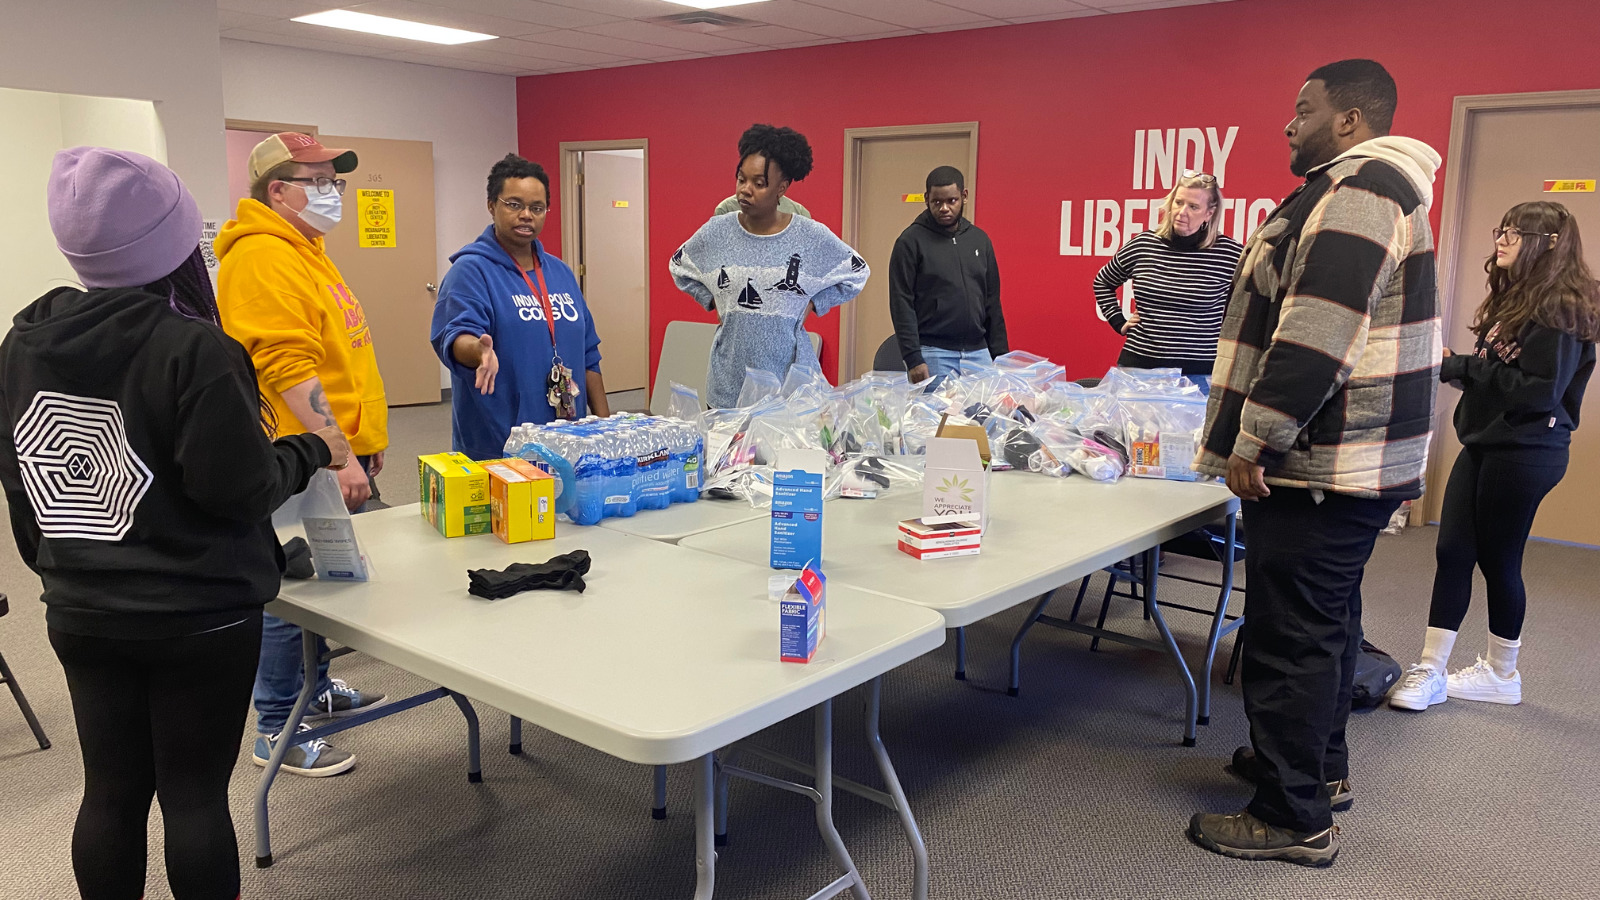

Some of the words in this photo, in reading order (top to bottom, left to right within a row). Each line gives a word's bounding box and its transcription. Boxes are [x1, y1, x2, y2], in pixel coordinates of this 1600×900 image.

[1132, 126, 1239, 189] INDY
[1059, 198, 1286, 256] LIBETIO
[201, 231, 217, 239] ATION
[511, 292, 574, 307] INDIAPOLIS
[518, 306, 562, 321] COLS
[637, 449, 669, 463] KIRKLAN
[631, 470, 660, 489] purified
